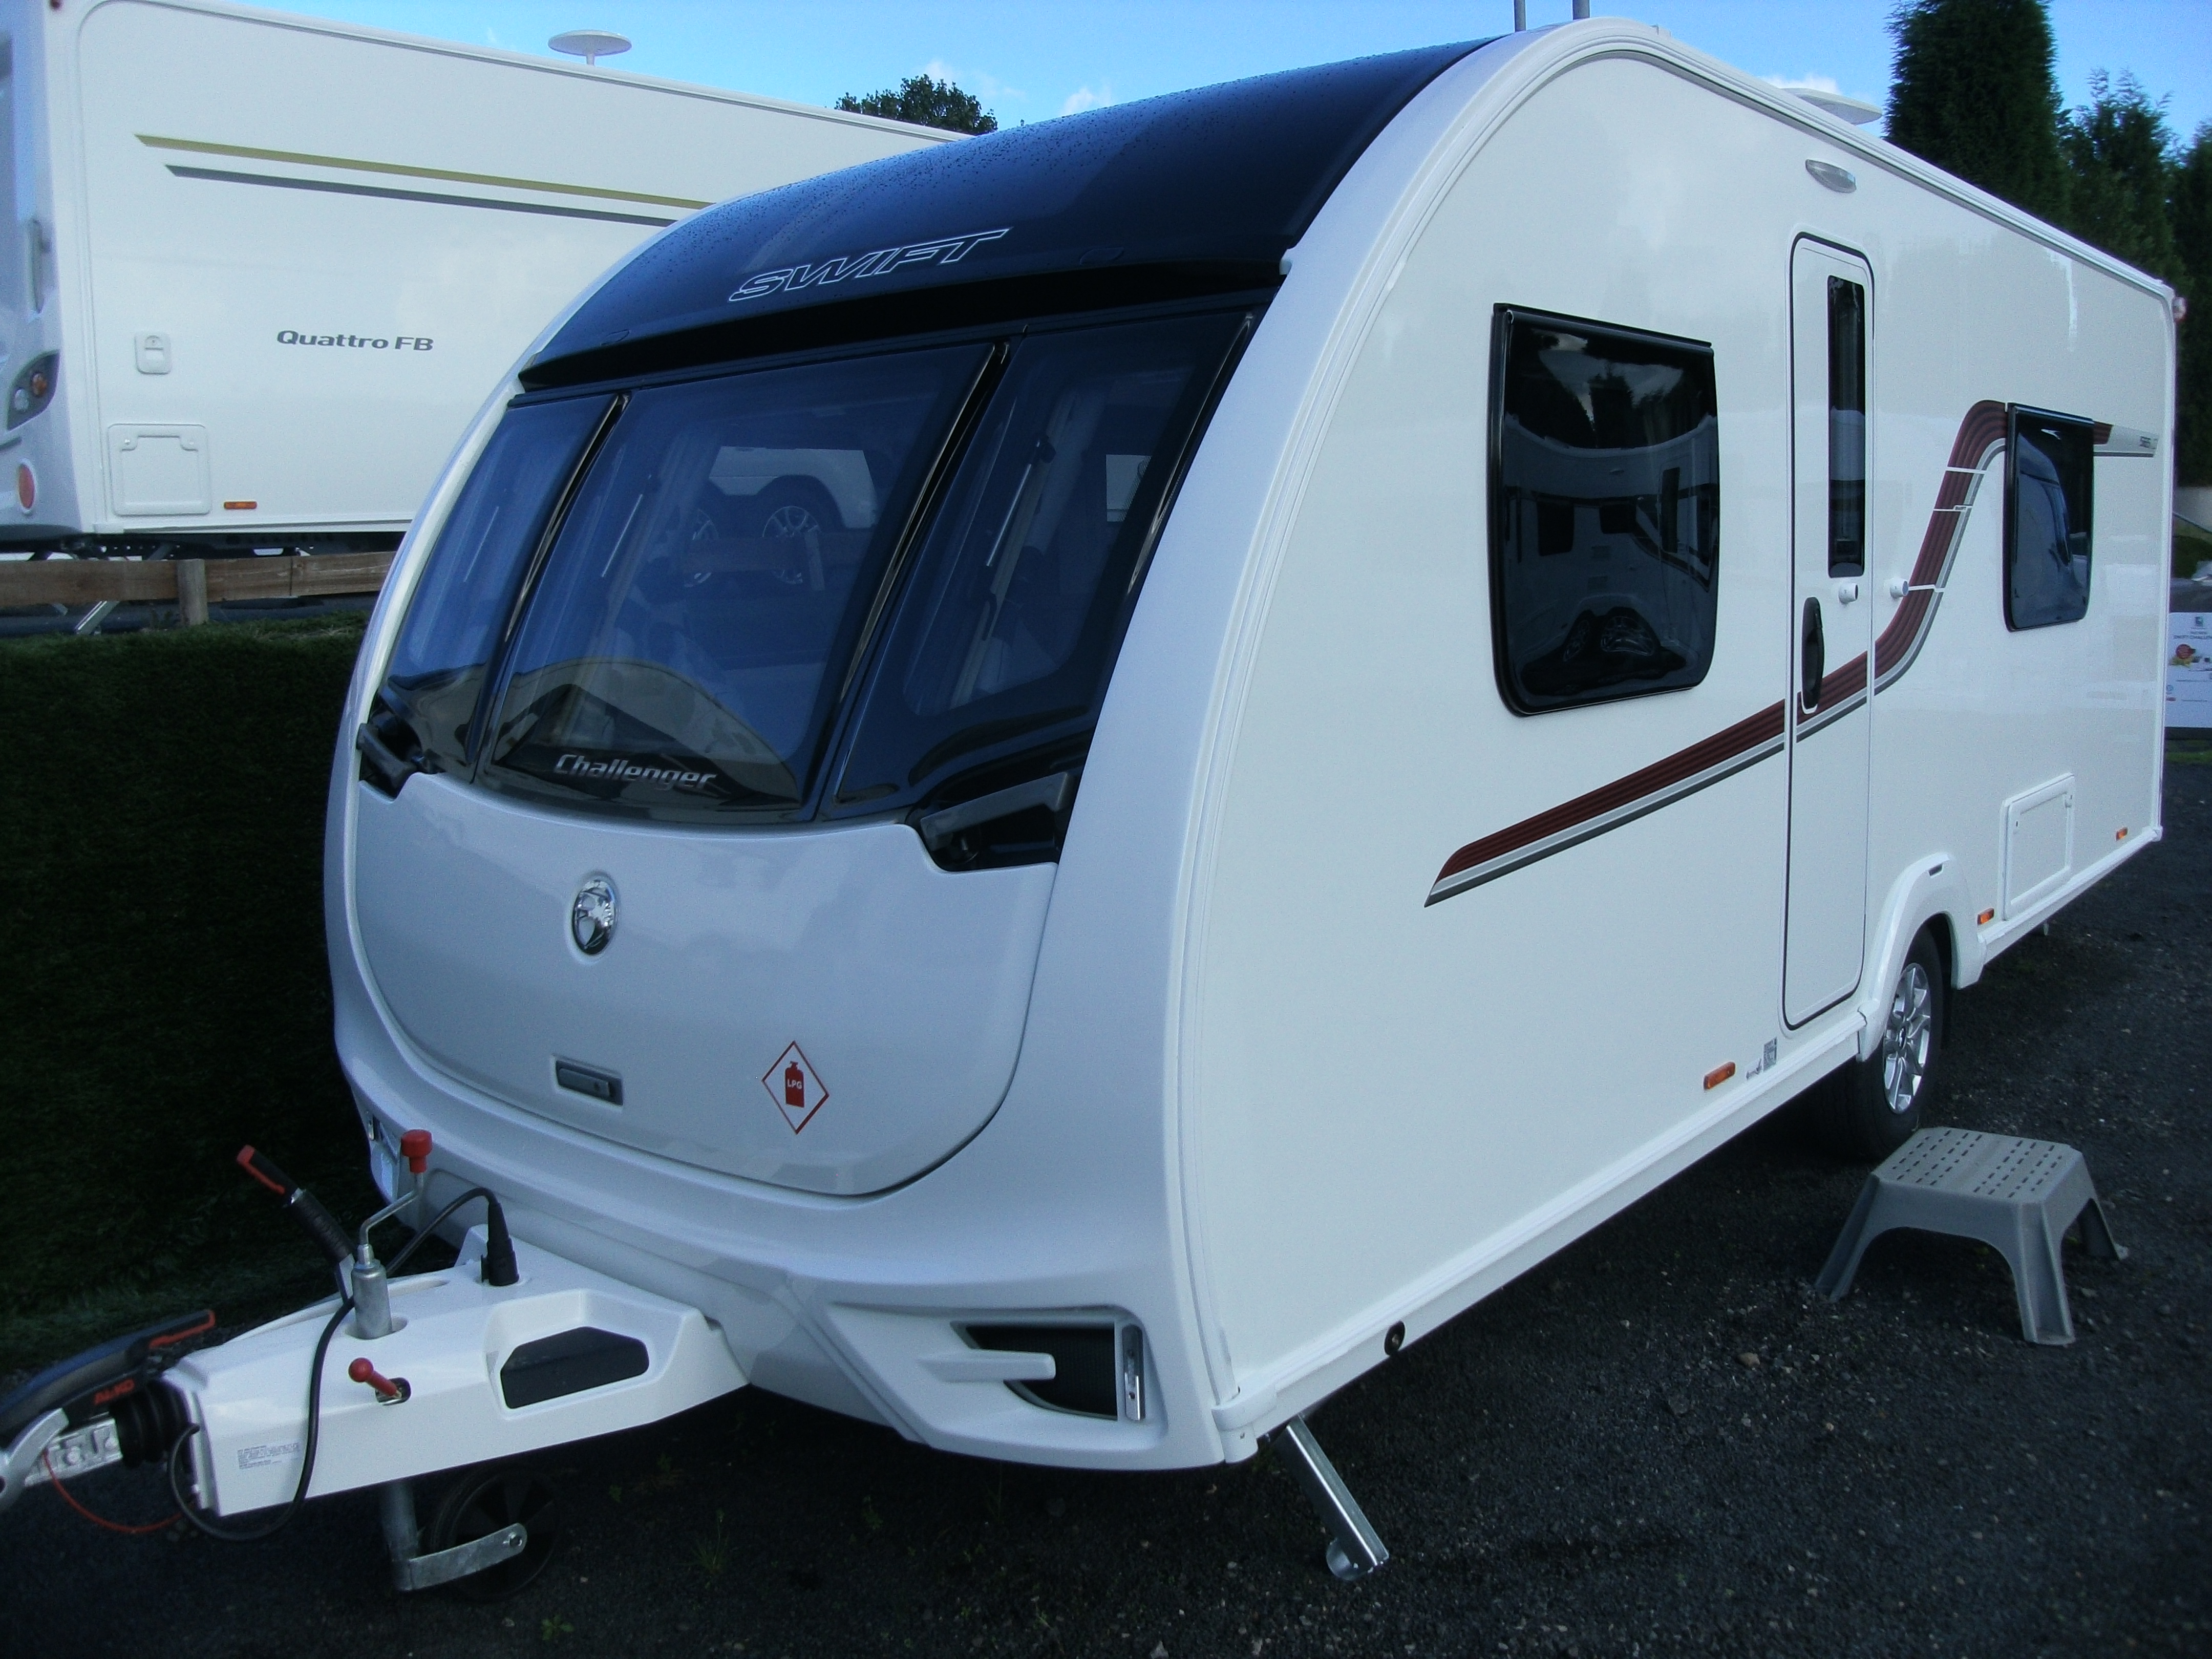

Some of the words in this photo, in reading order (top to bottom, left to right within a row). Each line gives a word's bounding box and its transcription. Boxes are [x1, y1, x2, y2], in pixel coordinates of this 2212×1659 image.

[729, 227, 1010, 302] SWIFT
[276, 330, 389, 349] Quattro
[395, 336, 434, 351] FB
[554, 754, 717, 790] Challenger
[787, 1079, 802, 1090] LPG
